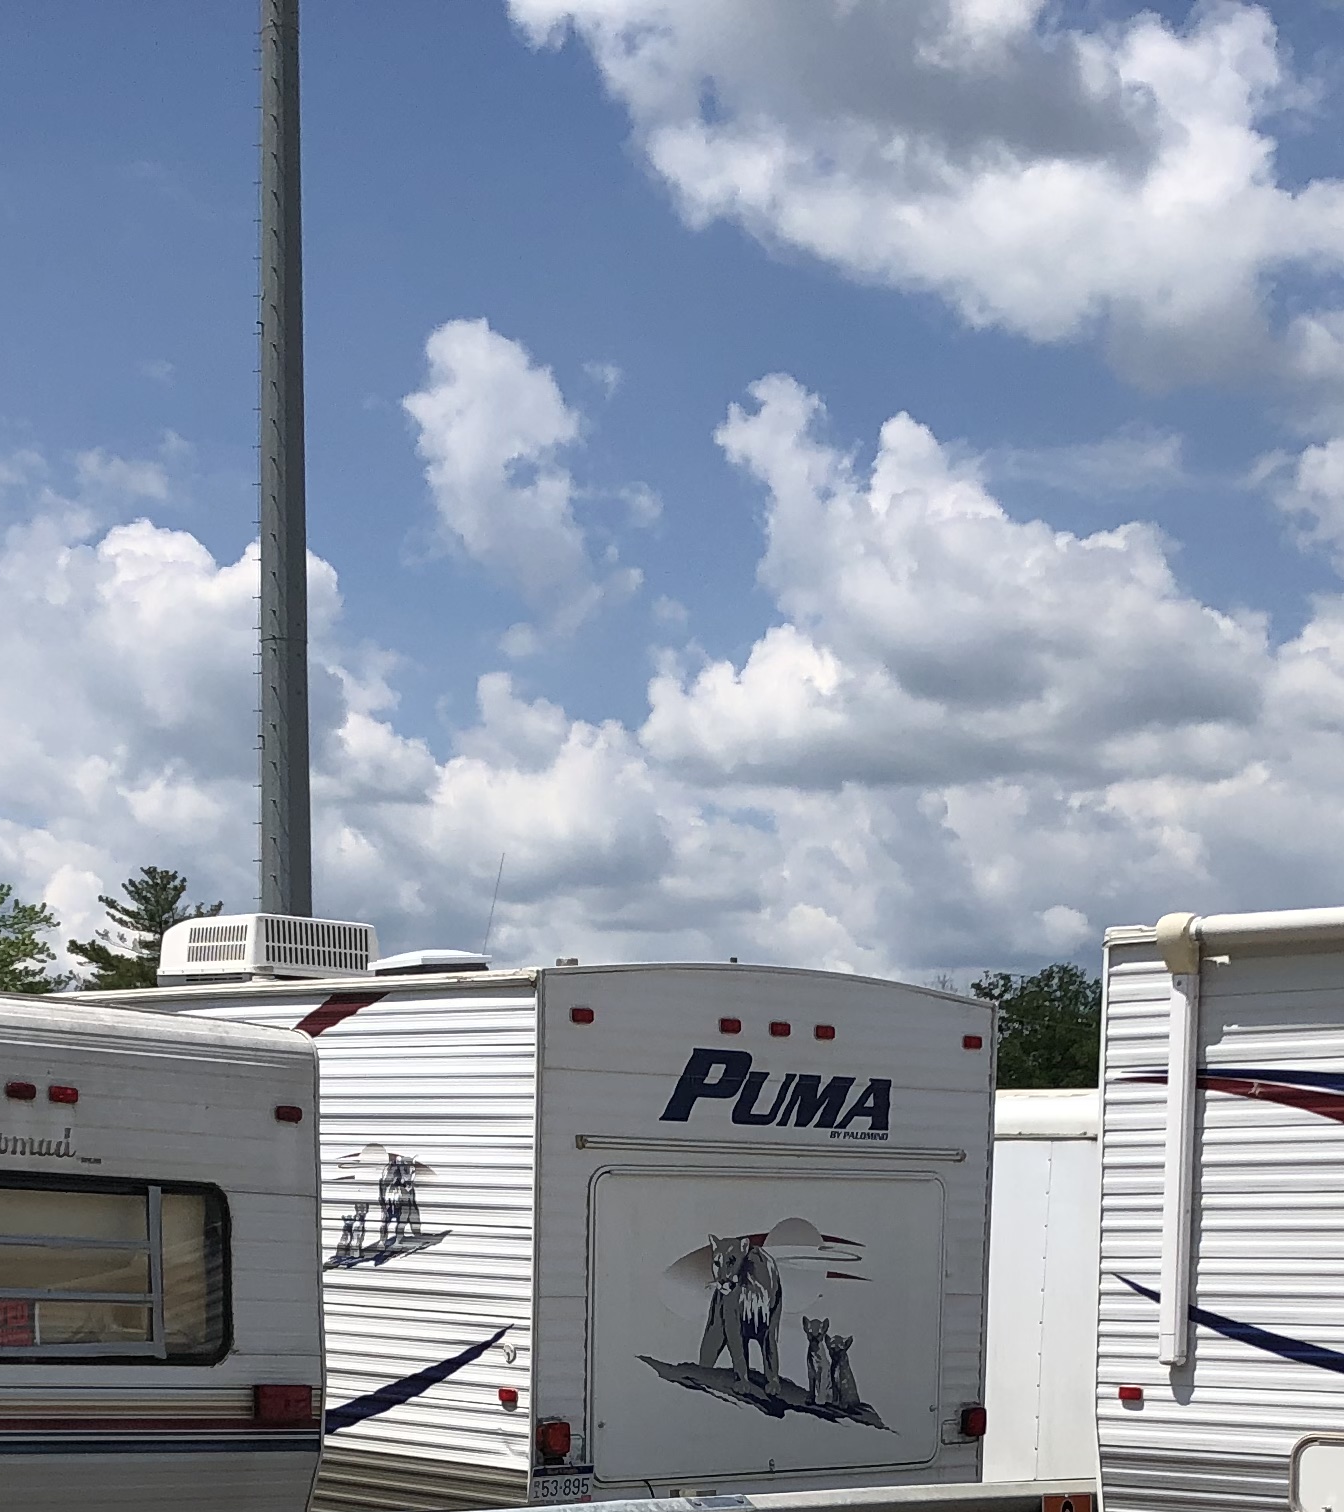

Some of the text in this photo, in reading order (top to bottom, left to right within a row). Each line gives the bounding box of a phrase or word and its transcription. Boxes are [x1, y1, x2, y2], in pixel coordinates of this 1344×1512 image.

[659, 1048, 892, 1131] PUMA
[843, 1132, 888, 1140] PALOMINO
[541, 1478, 590, 1498] 53-895
